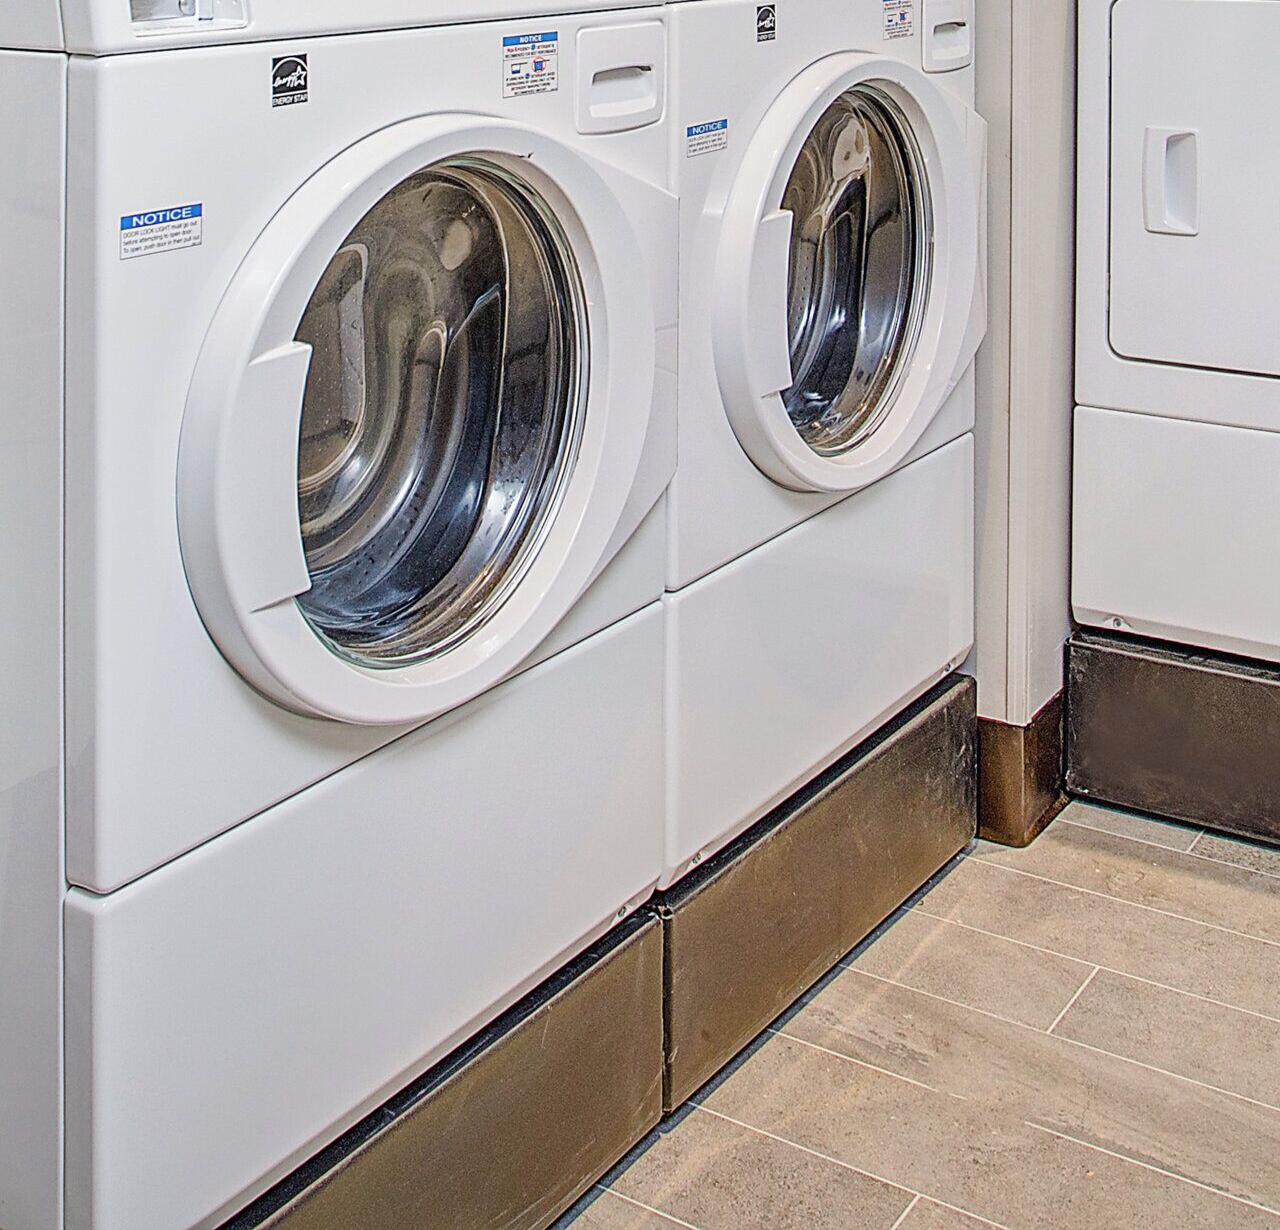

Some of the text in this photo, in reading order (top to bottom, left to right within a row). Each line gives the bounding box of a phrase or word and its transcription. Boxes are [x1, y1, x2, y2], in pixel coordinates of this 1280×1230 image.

[519, 35, 542, 43] NOTICE
[692, 122, 723, 135] NOTICE
[132, 207, 191, 227] NOTICE
